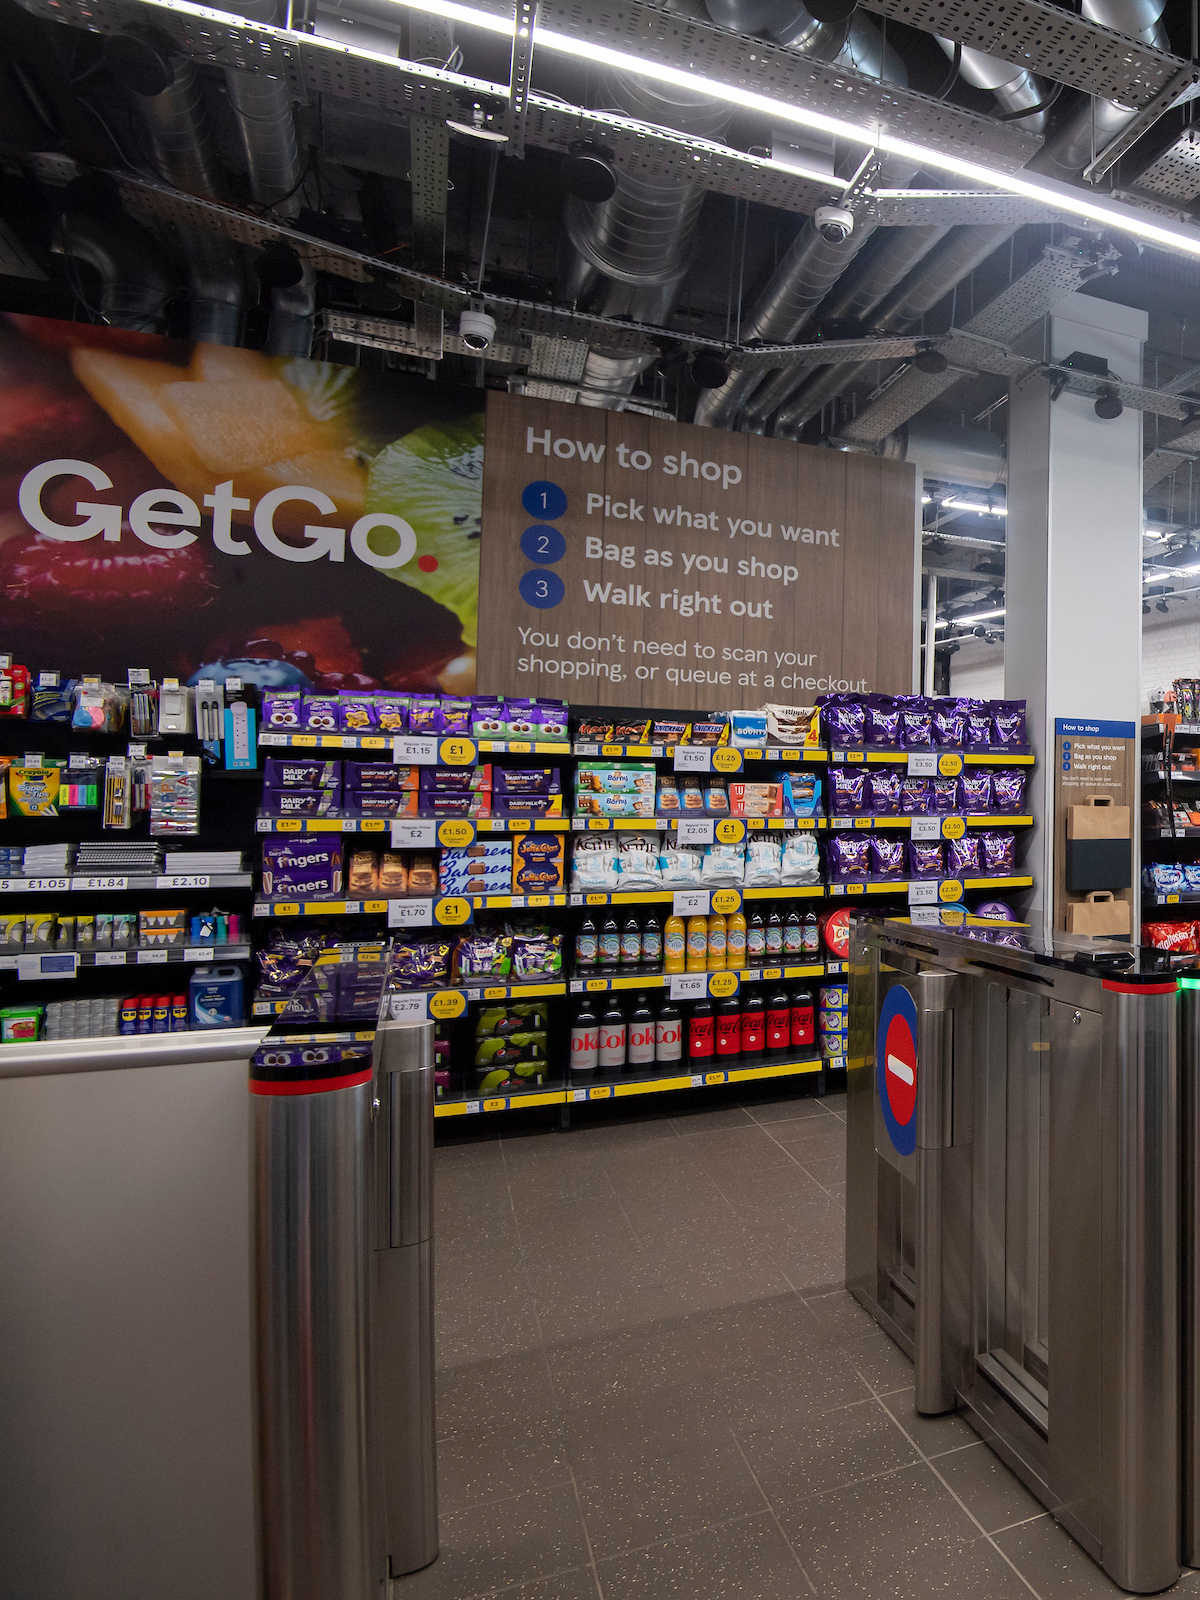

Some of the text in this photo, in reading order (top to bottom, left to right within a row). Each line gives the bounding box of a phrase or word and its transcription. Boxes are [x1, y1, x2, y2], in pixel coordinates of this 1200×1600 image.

[527, 426, 742, 490] How to shop
[540, 492, 840, 547] 1 Pick what you want
[537, 536, 799, 586] 2 Bag as you shop
[535, 580, 774, 619] 3 Walk right out
[518, 626, 559, 648] You
[633, 640, 686, 657] need
[694, 642, 716, 659] to
[722, 646, 768, 663] scan
[774, 650, 818, 668] your
[517, 654, 872, 694] shopping, or queue at a checkout.
[737, 728, 767, 736] BOUNTY
[1085, 725, 1100, 733] shop
[808, 729, 818, 742] 4
[450, 745, 464, 754] £1
[1074, 752, 1084, 760] Bag
[723, 824, 735, 833] £1
[520, 842, 558, 853] Jaffa Cakes
[172, 877, 207, 886] £2.10
[520, 872, 558, 882] Jaffa Cakes
[28, 880, 66, 888] £1.05
[88, 878, 124, 888] £1.84
[400, 908, 426, 916] £1.70
[444, 905, 458, 914] £1
[1156, 930, 1188, 950] Maltesers
[433, 998, 458, 1006] £1.39
[394, 1003, 420, 1011] £2.79
